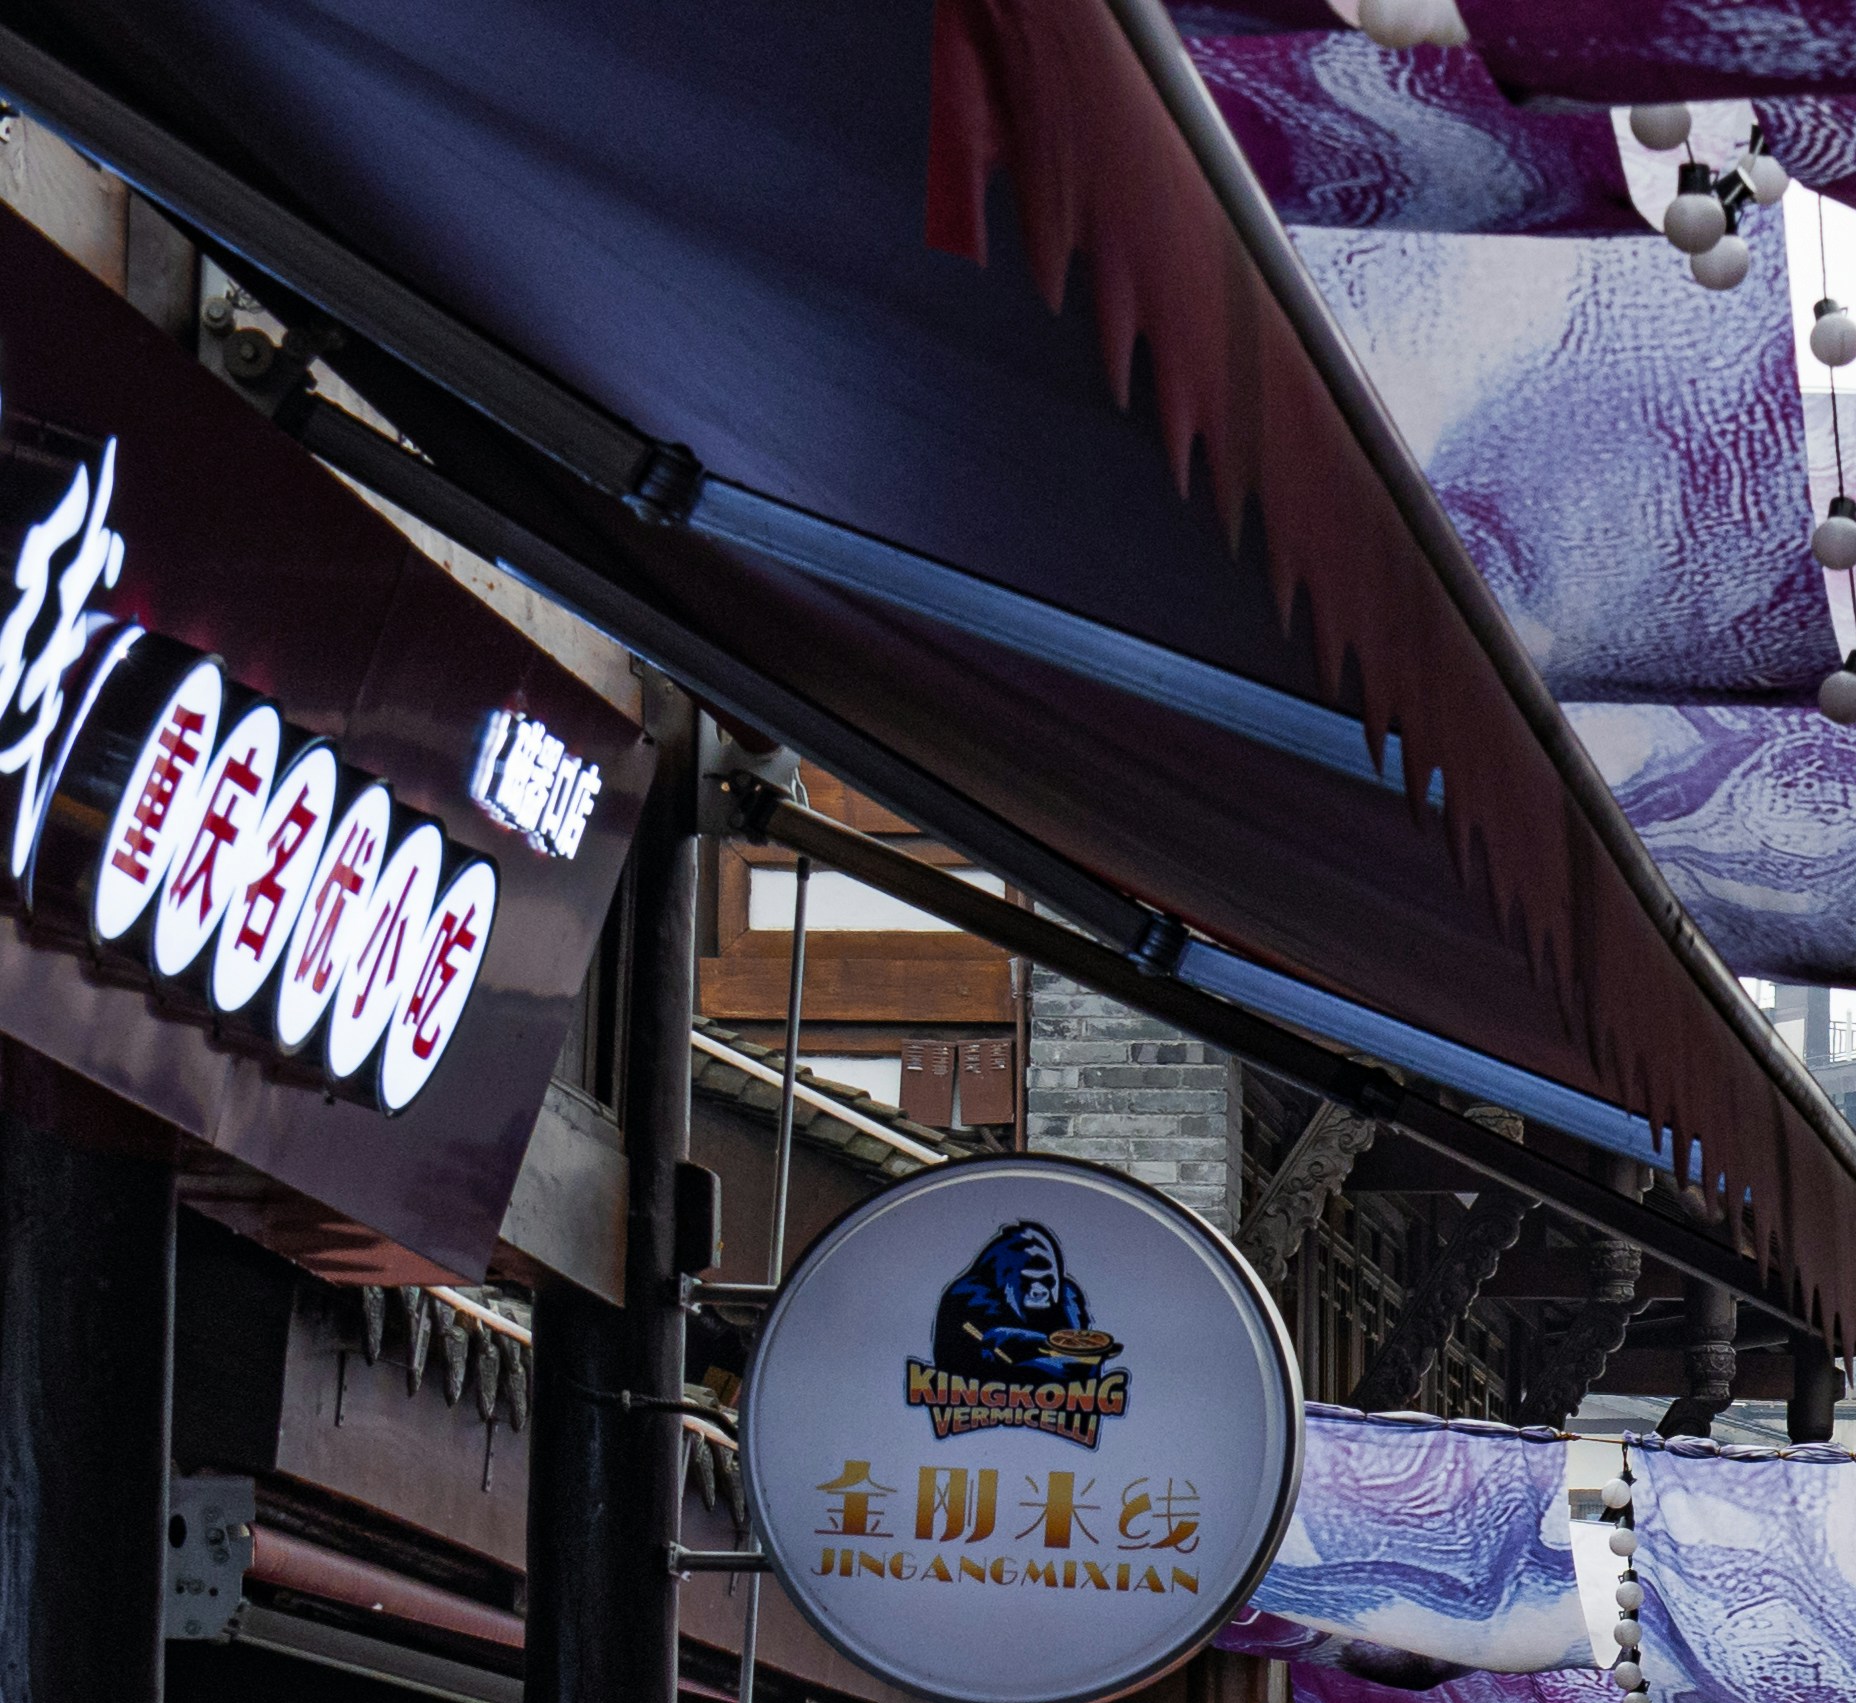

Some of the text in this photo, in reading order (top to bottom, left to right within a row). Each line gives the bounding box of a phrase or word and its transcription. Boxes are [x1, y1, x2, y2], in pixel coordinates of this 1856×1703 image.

[111, 704, 476, 1061] 重庆名优小吃
[908, 1361, 1127, 1417] KINGKONG
[933, 1407, 1098, 1446] VERMICELLI
[814, 1460, 1202, 1553] 金刚米线
[811, 1546, 1200, 1596] JINGANGMIXIAN
